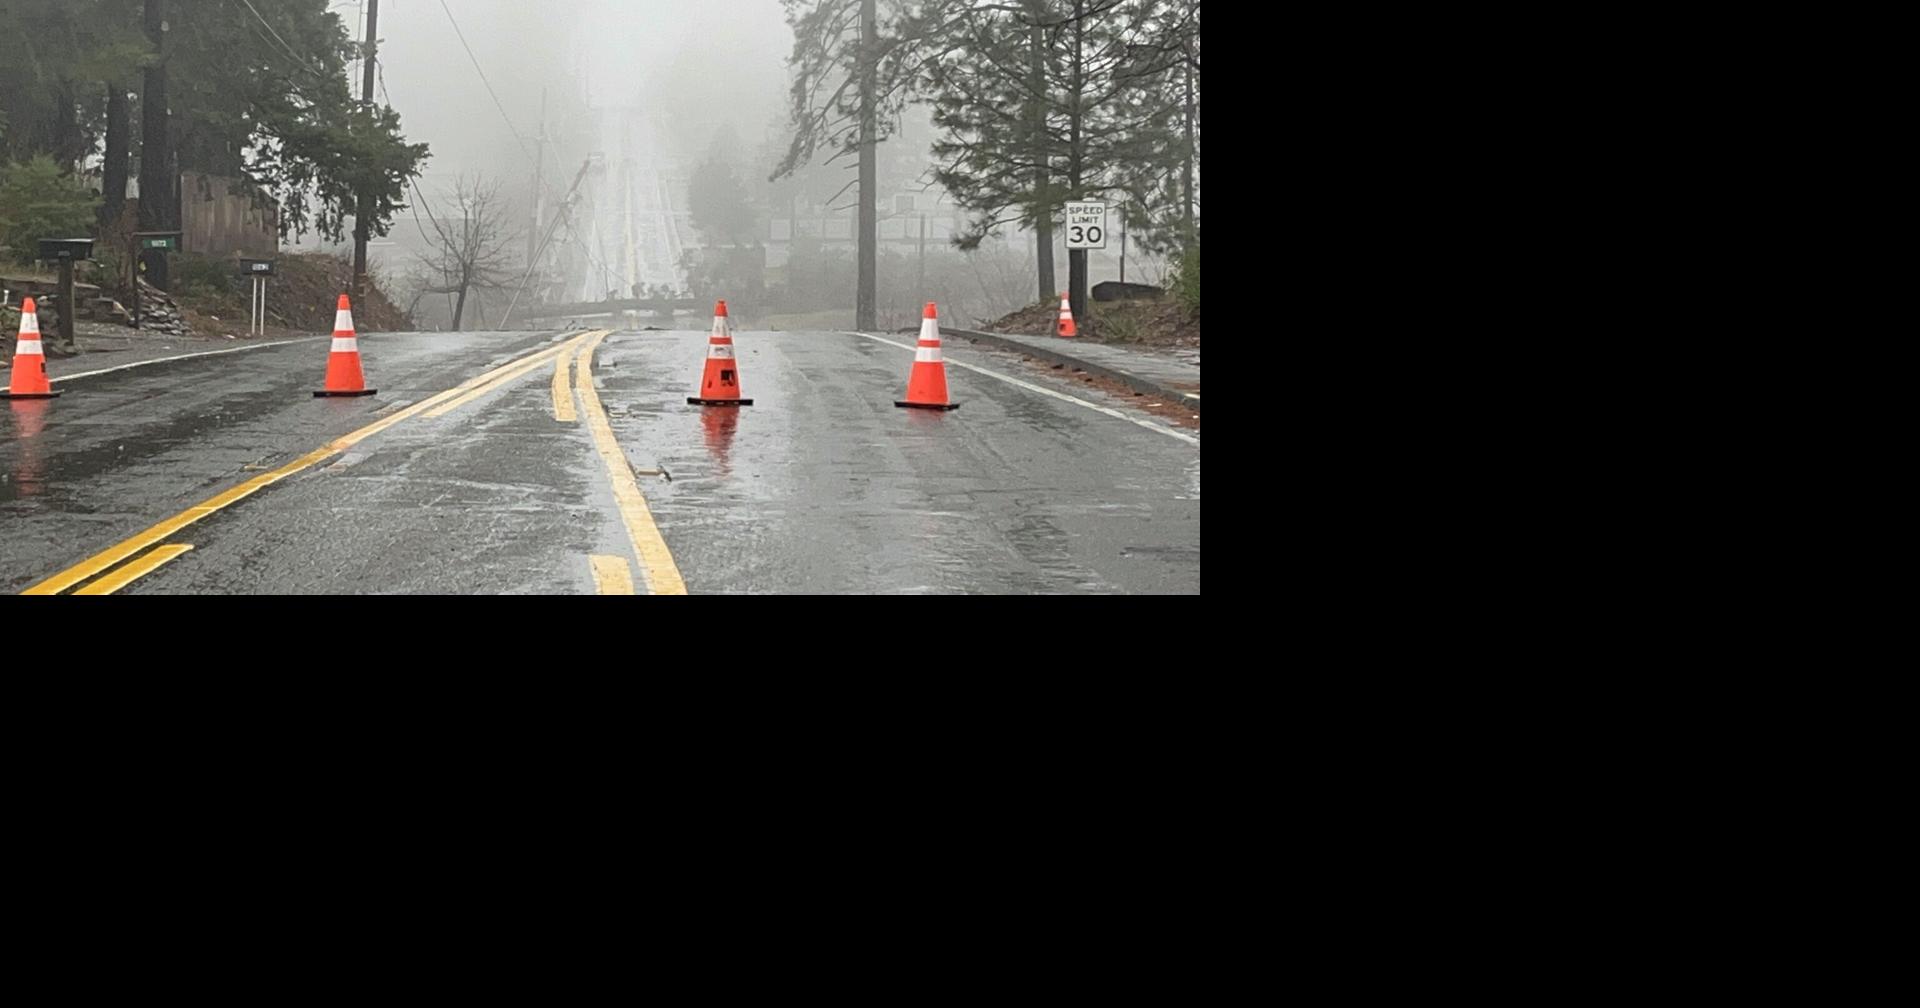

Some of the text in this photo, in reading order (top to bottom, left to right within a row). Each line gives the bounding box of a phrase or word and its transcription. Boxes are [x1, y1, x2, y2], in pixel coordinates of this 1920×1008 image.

[1069, 206, 1103, 215] SPEED
[1072, 216, 1099, 224] LIMIT
[1070, 226, 1102, 243] 30
